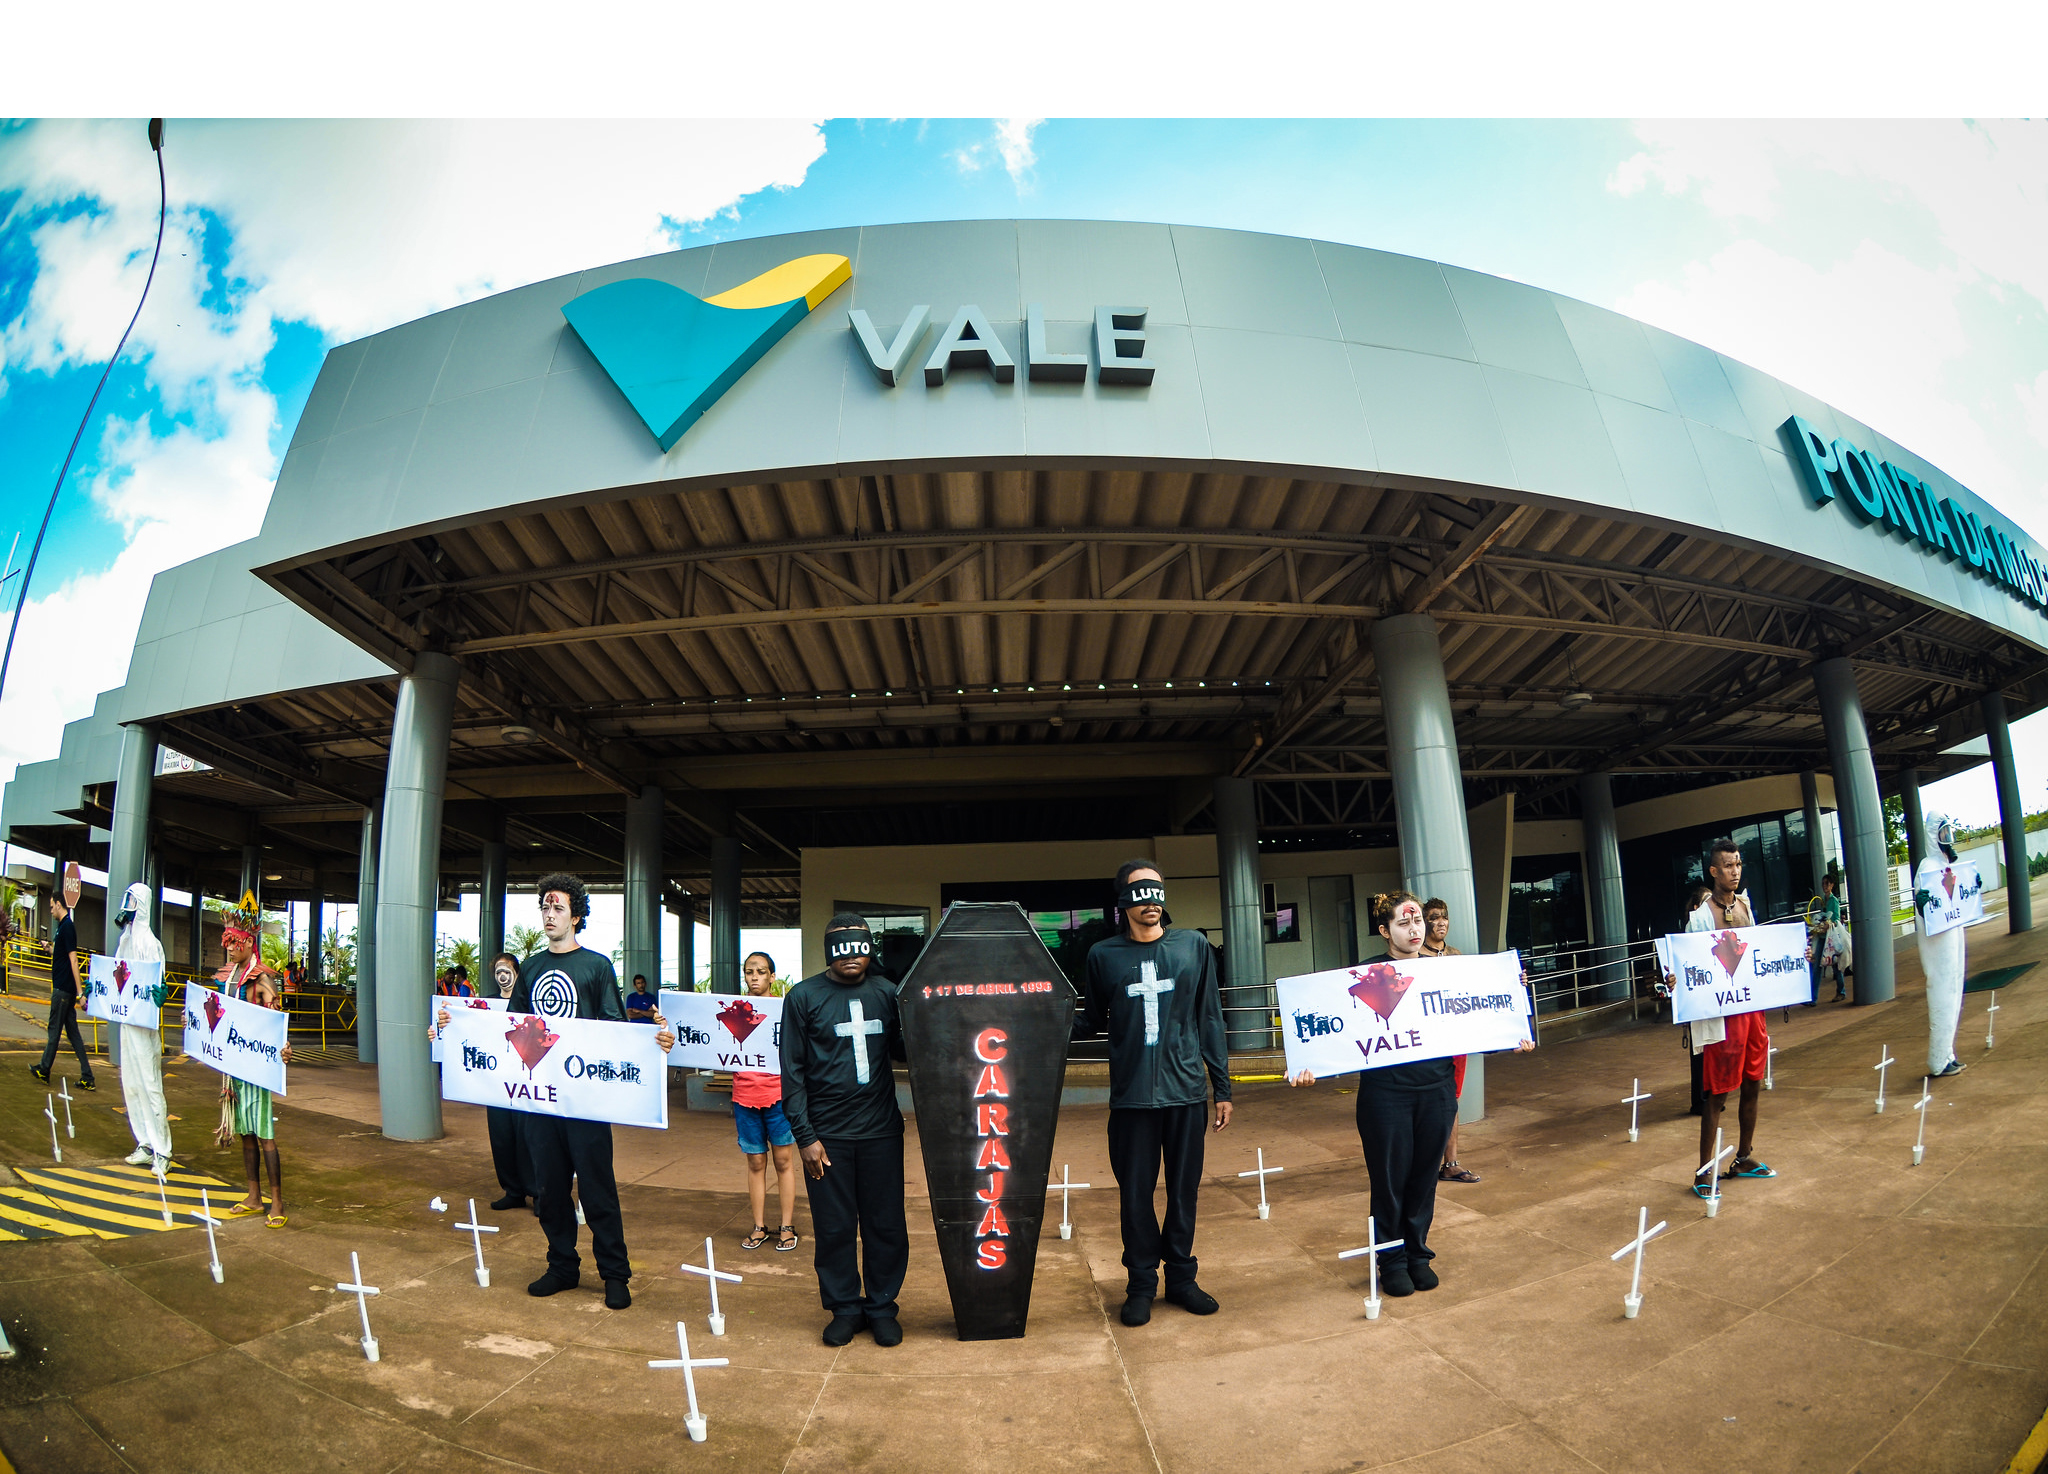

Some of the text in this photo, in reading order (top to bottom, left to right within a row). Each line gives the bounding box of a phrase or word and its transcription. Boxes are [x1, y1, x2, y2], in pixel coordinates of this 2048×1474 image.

[848, 304, 1155, 387] VALE
[1784, 415, 1960, 560] PONTA
[1940, 497, 2003, 580] DA
[65, 877, 79, 892] PARE
[1132, 888, 1165, 902] LUTO
[1945, 908, 1960, 922] VALE
[831, 941, 870, 957] LUTO
[936, 985, 952, 996] 17
[955, 984, 974, 996] DE
[976, 983, 1018, 995] ABRIL
[1715, 987, 1751, 1007] VALE
[111, 1004, 127, 1016] VALE
[202, 1041, 222, 1060] VALE
[1356, 1029, 1422, 1057] VALE
[717, 1053, 766, 1067] VALE
[504, 1082, 558, 1102] VALE
